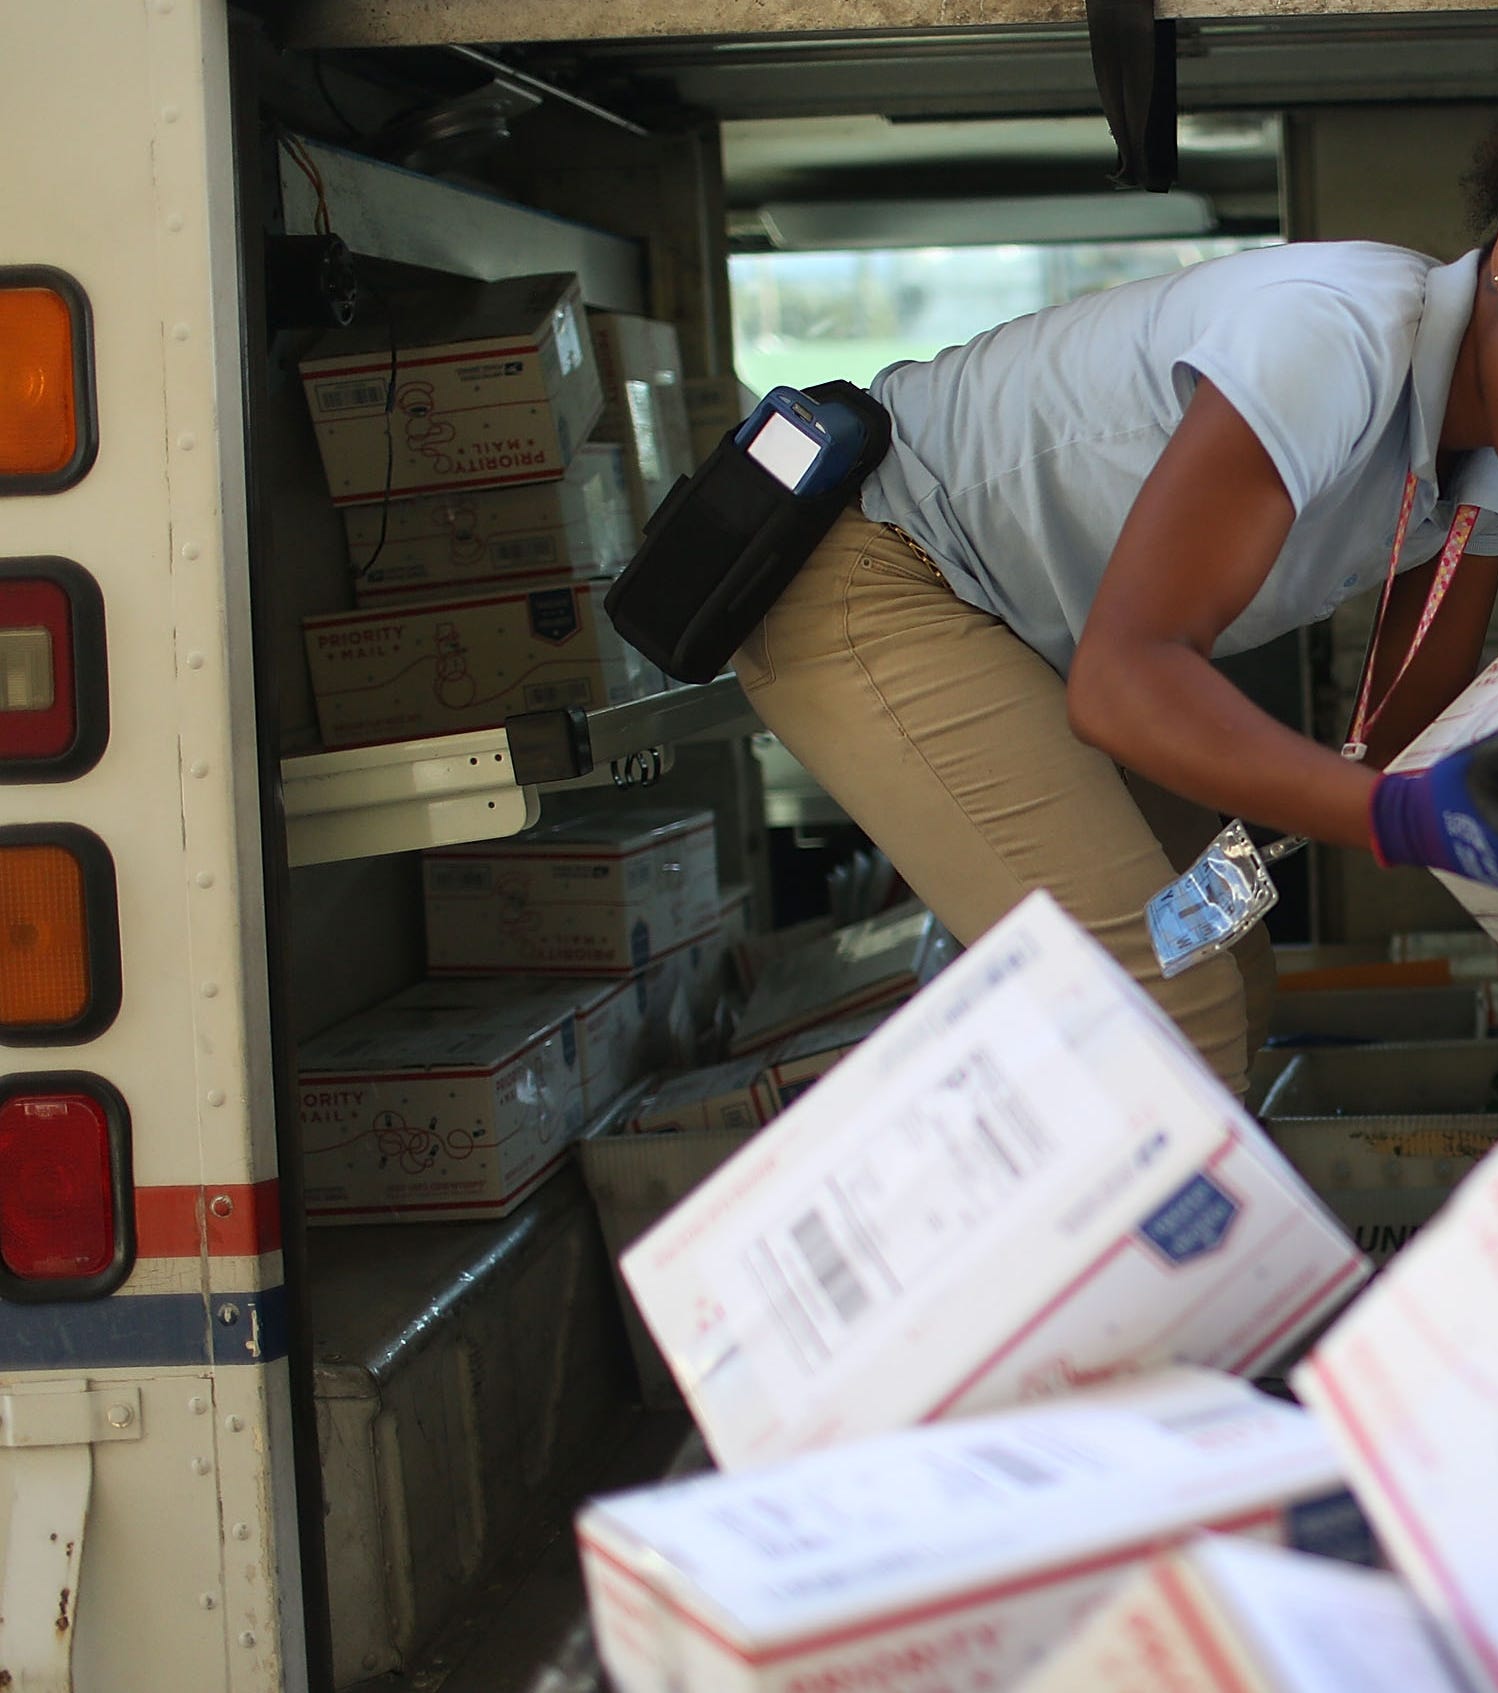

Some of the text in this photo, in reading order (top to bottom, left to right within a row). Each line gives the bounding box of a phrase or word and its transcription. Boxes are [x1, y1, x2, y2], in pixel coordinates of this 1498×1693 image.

[472, 438, 521, 453] MAIL
[453, 450, 545, 473] PRIORITY
[318, 625, 405, 649] PRIORITY
[340, 646, 386, 661] MAIL
[303, 1091, 364, 1107] ORITY
